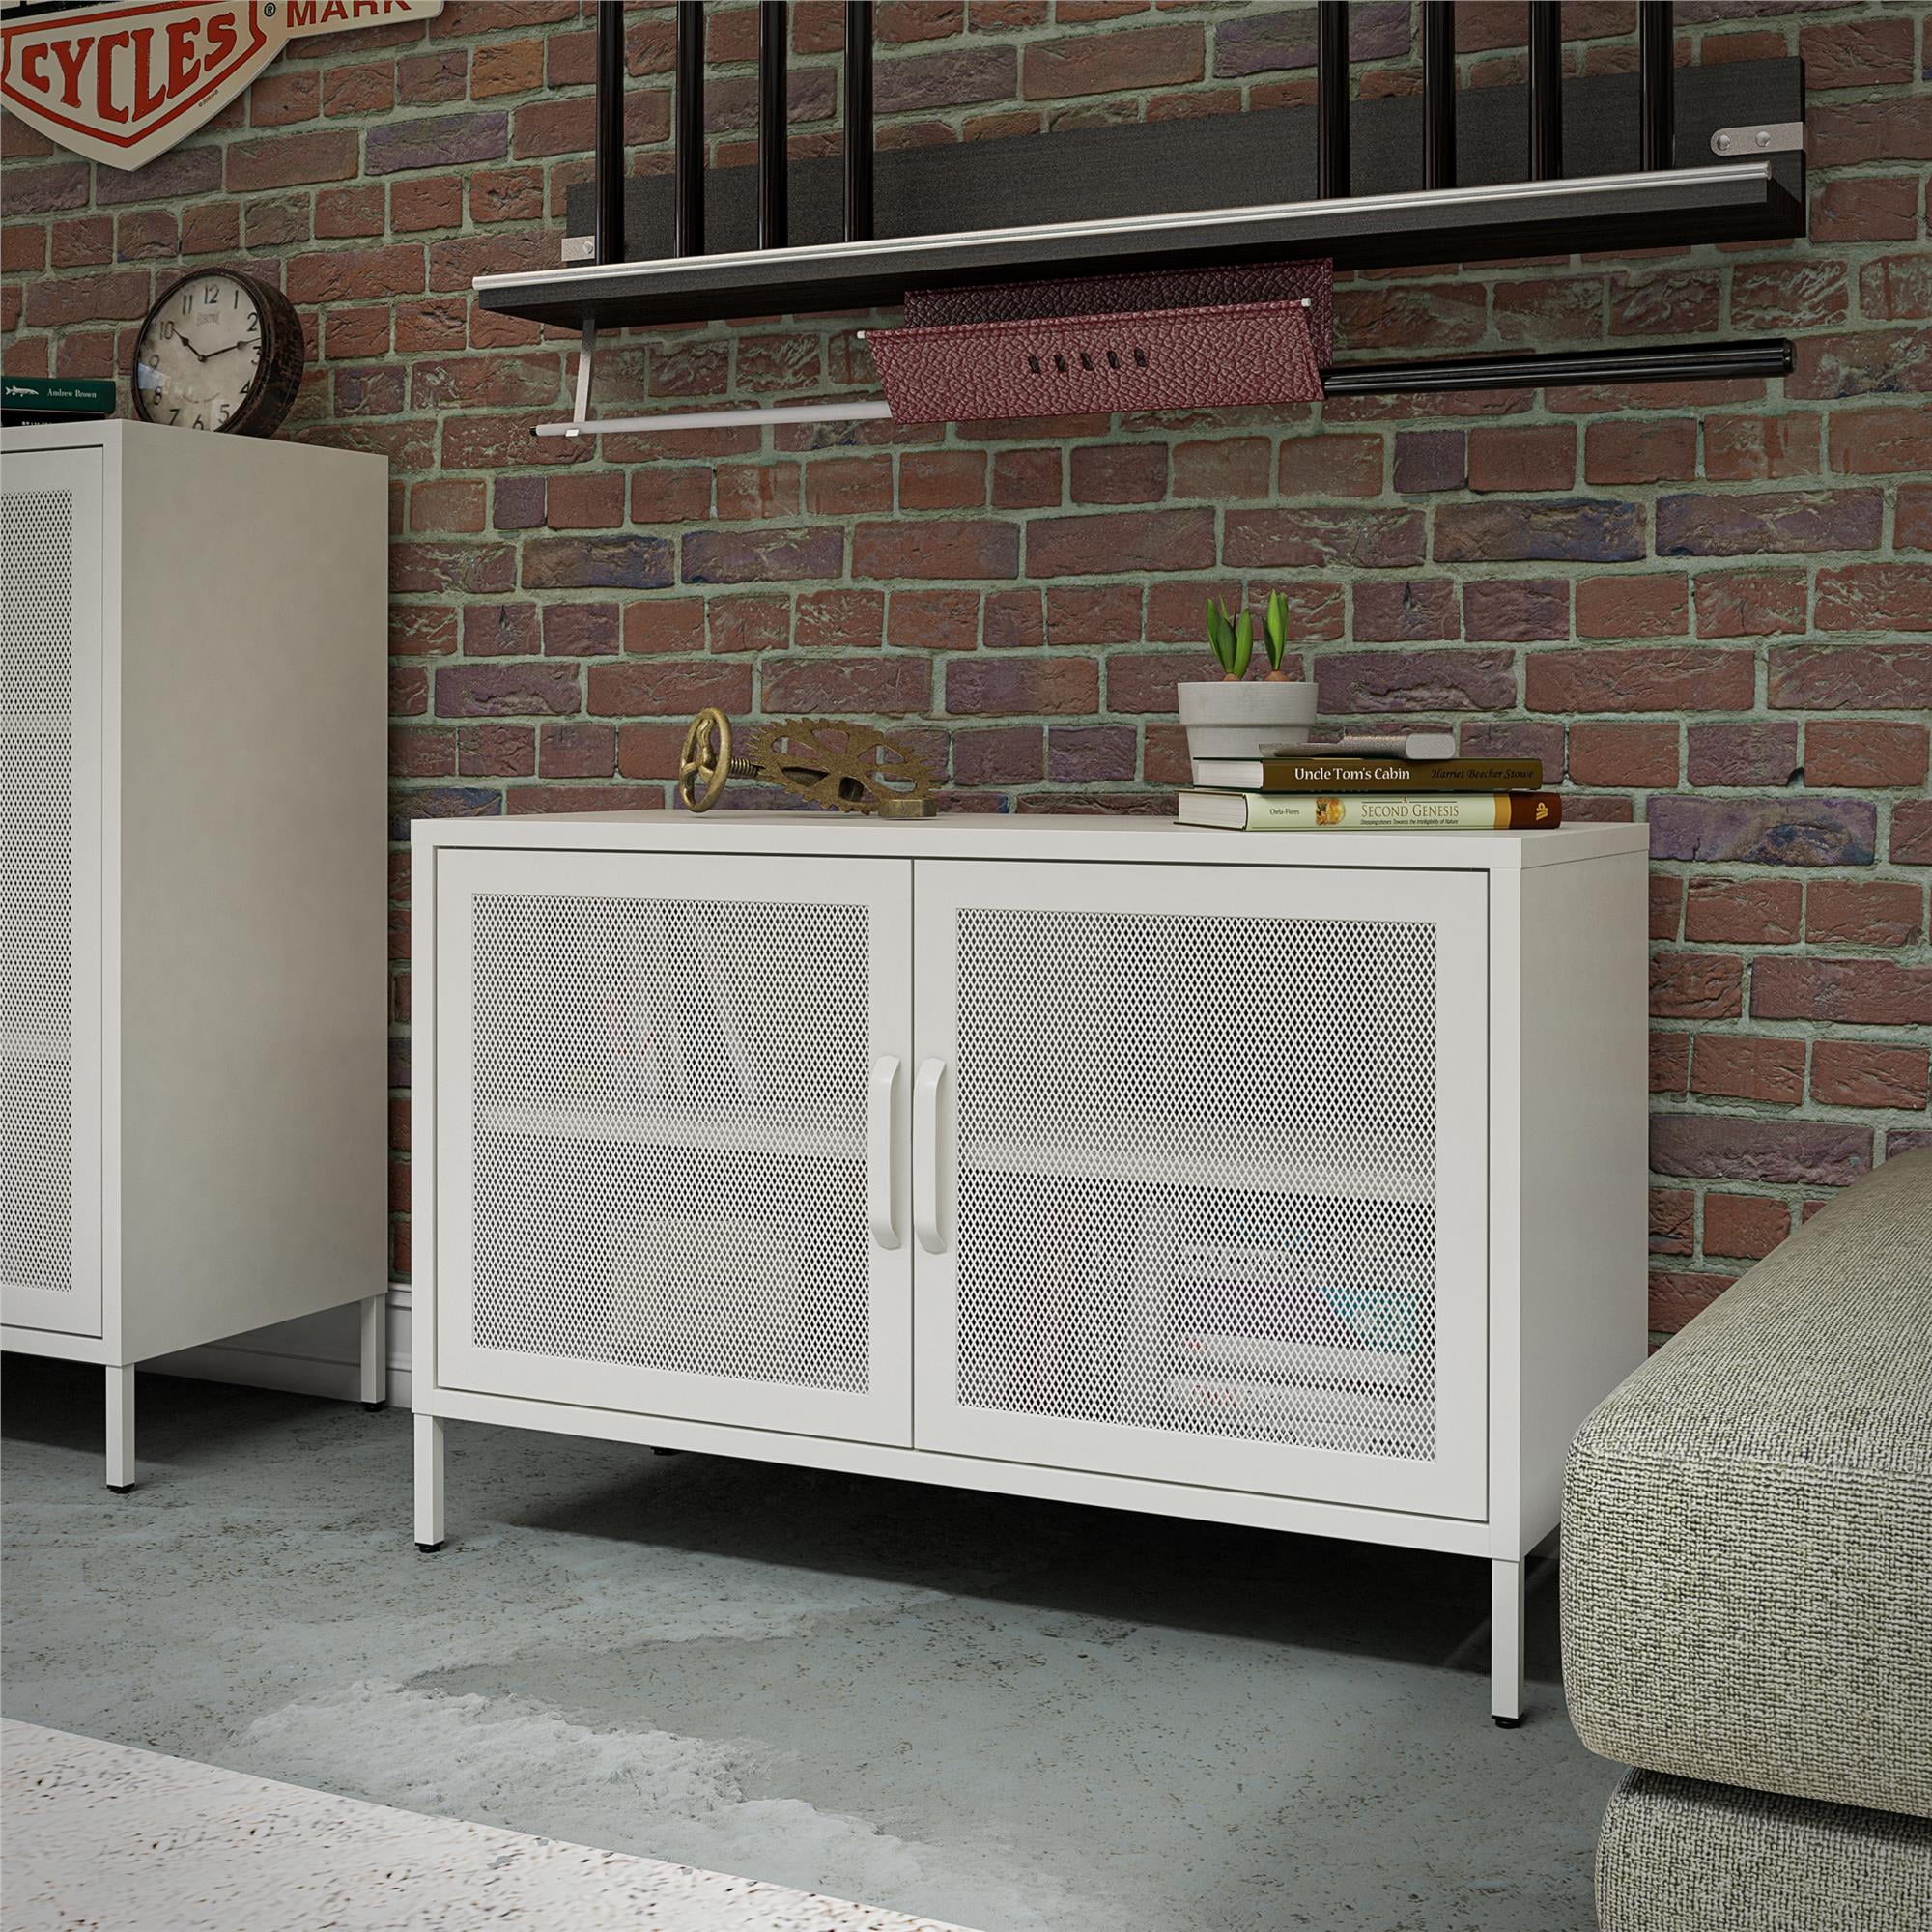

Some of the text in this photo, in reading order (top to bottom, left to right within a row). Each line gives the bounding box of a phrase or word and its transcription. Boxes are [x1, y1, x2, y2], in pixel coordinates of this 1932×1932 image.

[21, 12, 238, 124] CYCLES
[204, 284, 219, 304] 12
[234, 290, 240, 309] 1
[182, 295, 193, 315] 11
[160, 321, 174, 340] 10
[246, 311, 258, 332] 2
[149, 354, 159, 373] 9
[251, 345, 261, 365] 3
[47, 388, 97, 398] Andrew Brown
[154, 386, 162, 405] 8
[238, 380, 250, 394] 4
[169, 408, 181, 426] 7
[193, 414, 204, 430] 6
[218, 404, 230, 425] 5
[1294, 767, 1410, 780] Uncle Tom's Cabin
[1431, 769, 1533, 779] Harriet Beecher Stowe
[1361, 804, 1459, 817] SECOND GENESIS
